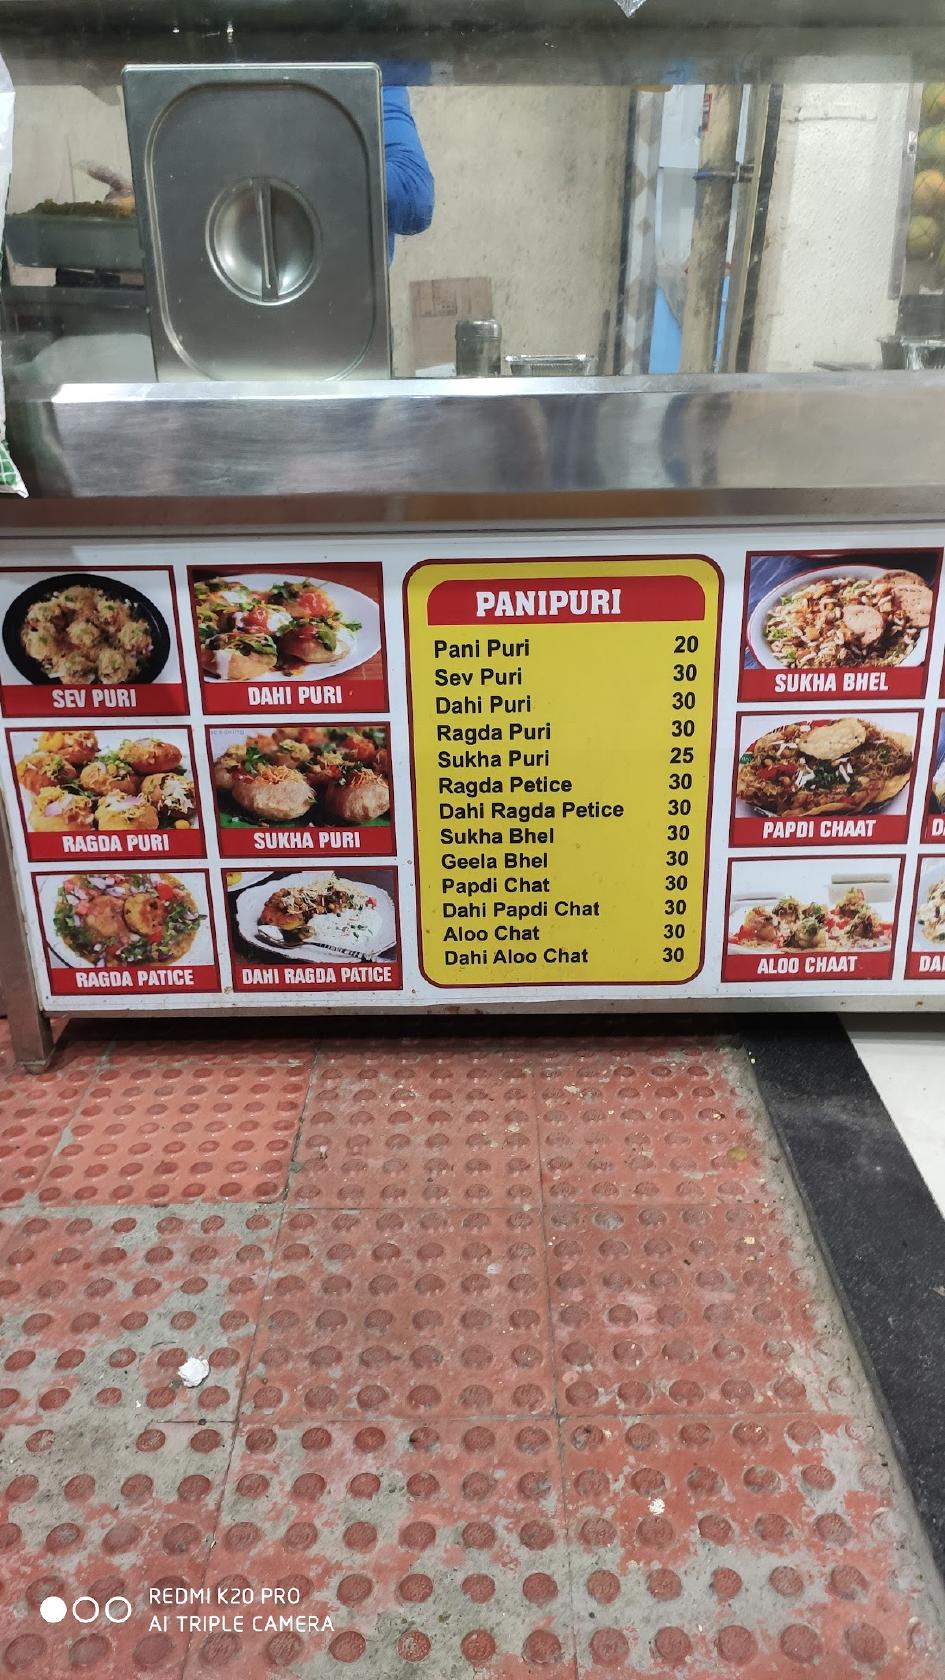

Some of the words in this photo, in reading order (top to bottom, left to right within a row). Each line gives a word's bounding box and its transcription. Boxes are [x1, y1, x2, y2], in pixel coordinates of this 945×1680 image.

[476, 589, 621, 616] PANIPURI
[435, 640, 479, 658] Pani
[488, 639, 529, 657] Puri
[674, 636, 698, 653] 20
[435, 669, 473, 686] Sev
[481, 667, 521, 685] Puri
[674, 664, 697, 681] 30
[775, 673, 836, 692] SUKHA
[843, 672, 888, 691] BHEL
[53, 690, 85, 707] SEV
[92, 689, 136, 707] PURI
[248, 687, 291, 705] DAHI
[299, 686, 342, 704] PURI
[672, 692, 695, 710] 30
[436, 696, 481, 714] Dahi
[491, 695, 530, 713] Puri
[437, 724, 502, 745] Ragda
[510, 723, 550, 740] Puri
[672, 720, 694, 737] 30
[438, 751, 501, 768] Sukha
[509, 750, 548, 766] Puri
[670, 747, 693, 763] 25
[439, 777, 503, 798] Ragda
[511, 776, 572, 792] Petice
[669, 774, 692, 789] 30
[440, 803, 484, 819] Dahi
[492, 802, 555, 822] Ragda
[563, 802, 624, 817] Petice
[668, 799, 691, 815] 30
[441, 828, 502, 844] Sukha
[510, 828, 553, 843] Bhel
[668, 825, 689, 840] 30
[763, 821, 814, 838] PAPDI
[820, 820, 876, 837] CHAAT
[932, 819, 945, 836] D
[63, 835, 122, 852] RAGDA
[127, 834, 169, 851] PURI
[254, 832, 313, 849] SUKHA
[319, 832, 360, 848] PURI
[442, 854, 497, 869] Geela
[505, 853, 547, 868] Bhel
[666, 851, 688, 866] 30
[442, 878, 497, 897] Papdi
[505, 877, 549, 892] Chat
[666, 875, 687, 891] 30
[443, 903, 486, 918] Dahi
[494, 902, 547, 920] Papdi
[555, 901, 599, 916] Chat
[665, 900, 686, 915] 30
[443, 927, 488, 941] Aloo
[495, 926, 539, 941] Chat
[664, 924, 685, 939] 30
[445, 950, 487, 965] Dahi
[493, 949, 537, 964] Aloo
[544, 948, 588, 963] Chat
[663, 947, 684, 962] 30
[757, 958, 799, 973] ALOO
[805, 956, 857, 973] CHAAT
[919, 955, 945, 972] DA
[76, 970, 133, 987] RAGDA
[138, 970, 194, 985] PATICE
[243, 969, 279, 984] DAHI
[285, 968, 336, 983] RAGDA
[341, 967, 391, 982] PATICE
